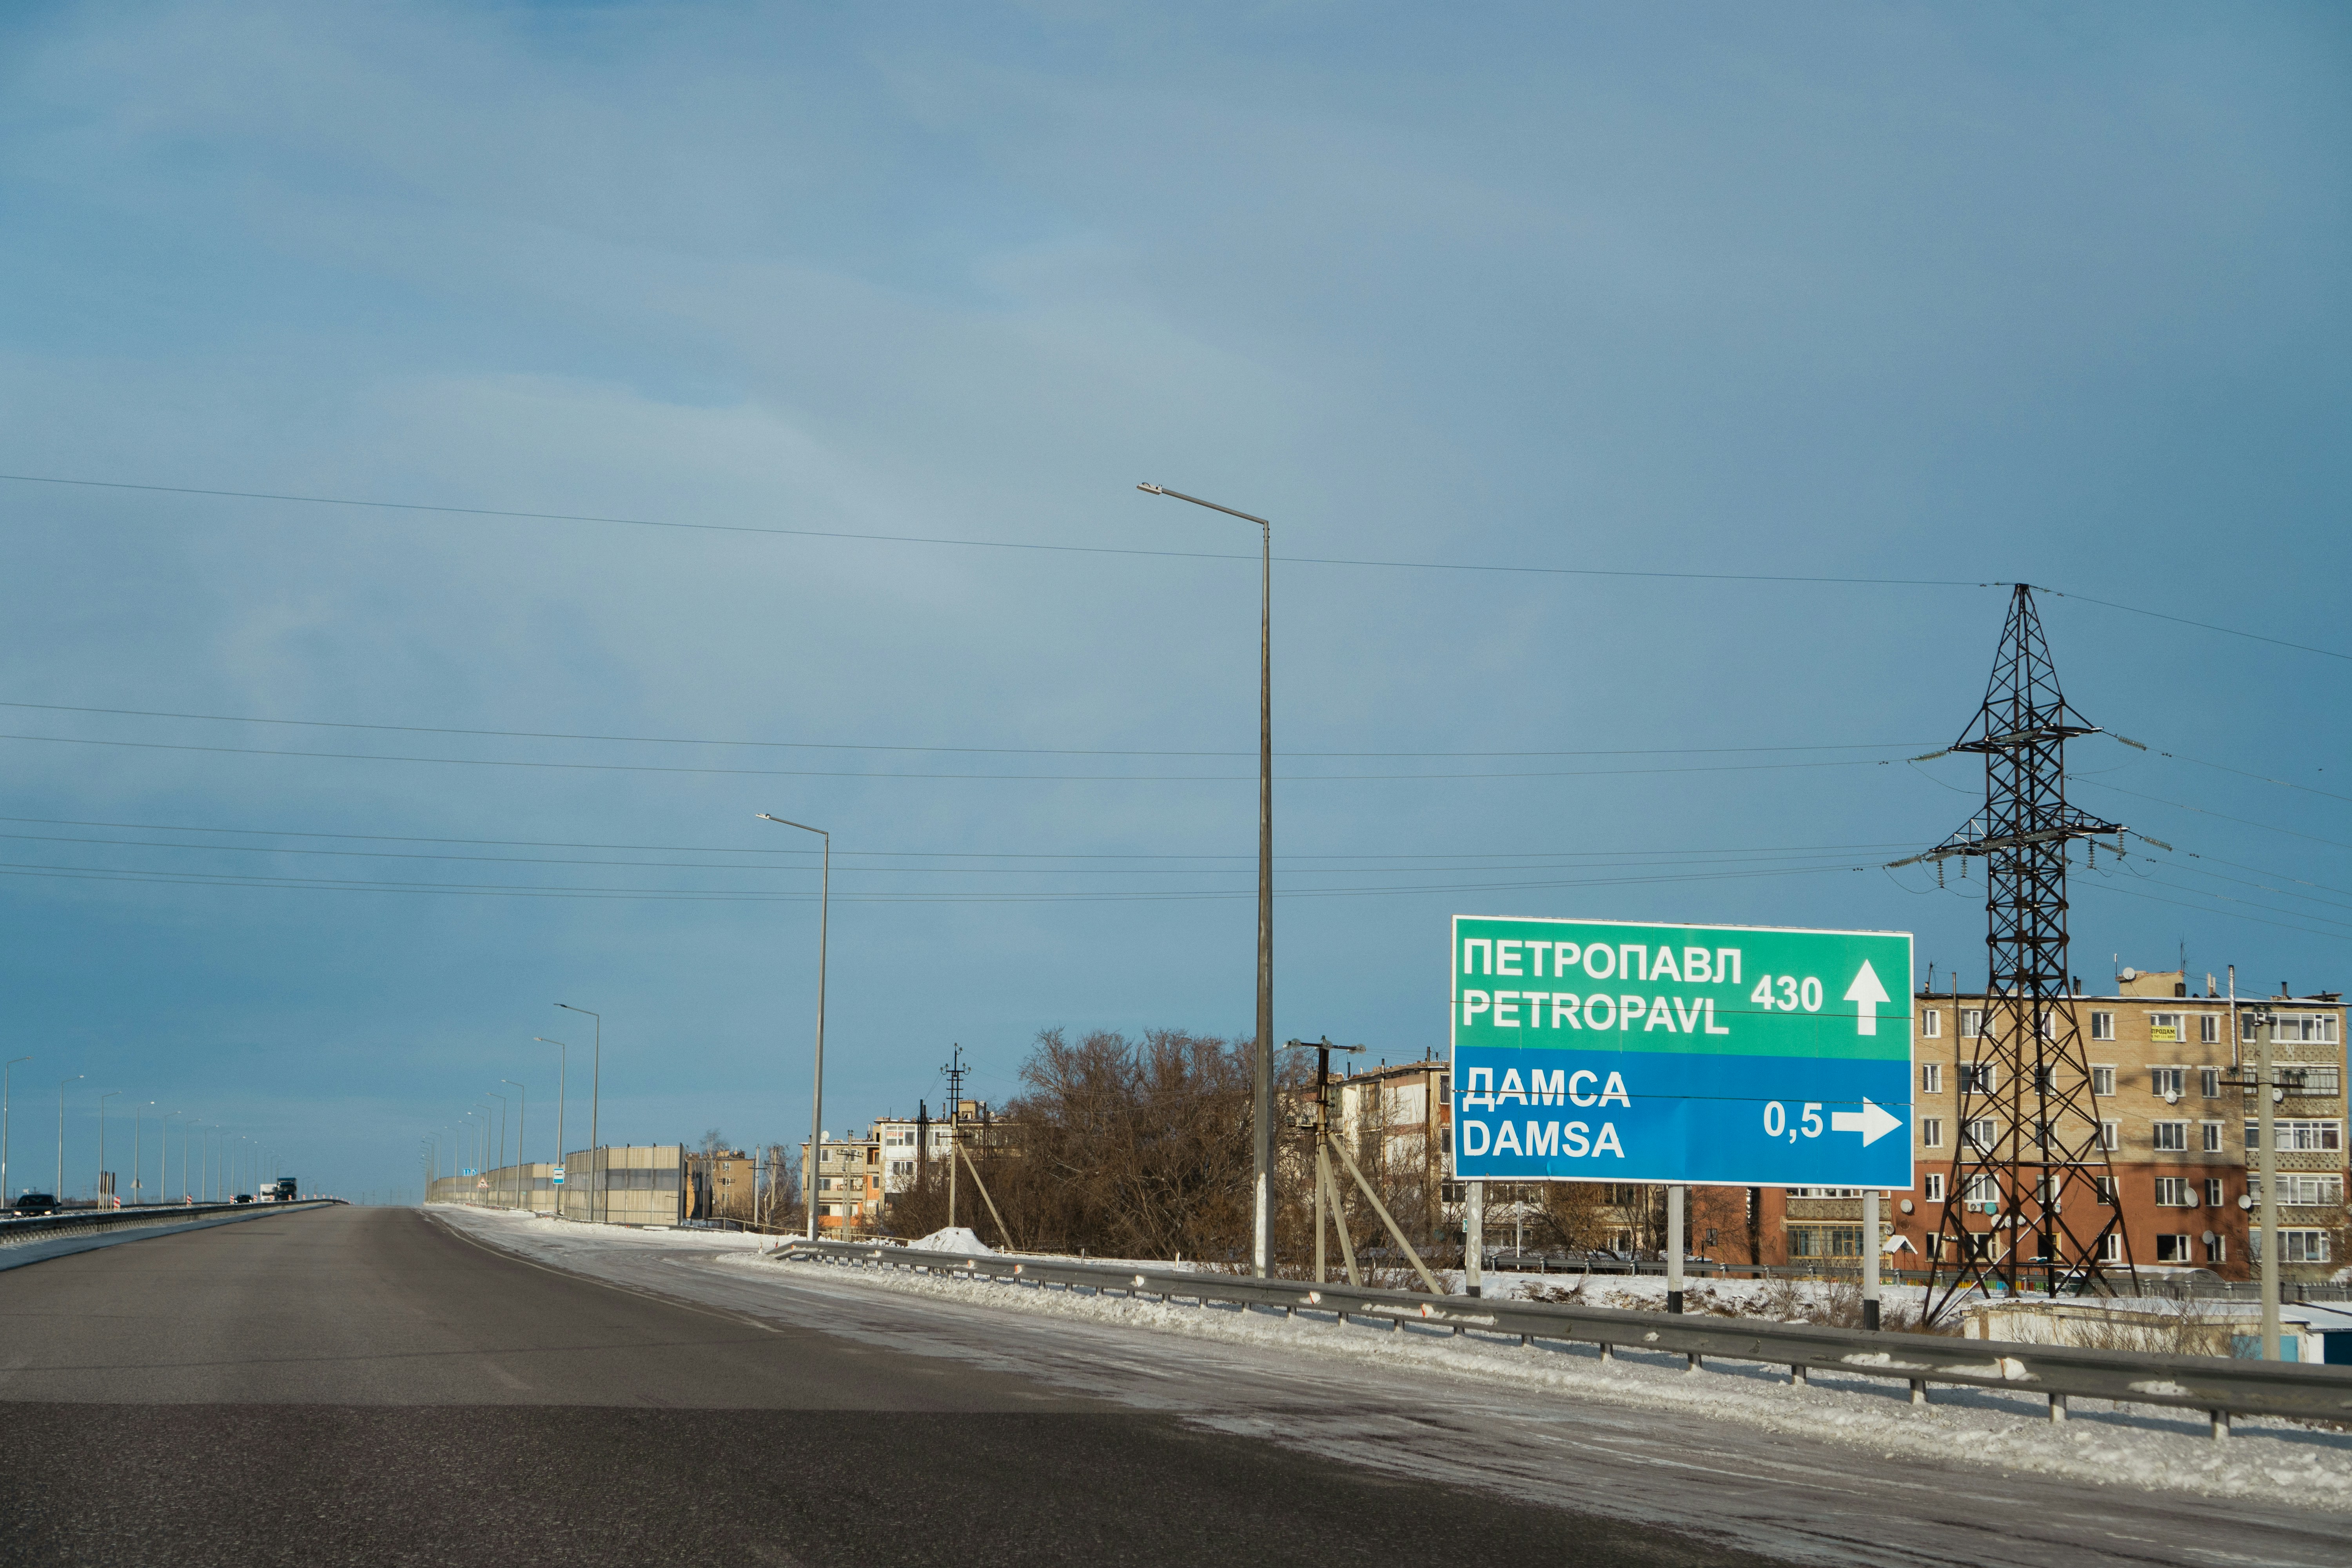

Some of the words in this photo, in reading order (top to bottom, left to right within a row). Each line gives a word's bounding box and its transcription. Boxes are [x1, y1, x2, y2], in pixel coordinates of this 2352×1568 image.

[1464, 938, 1741, 984] ПЕТРОПАВЛ
[1463, 989, 1729, 1034] PETROPAVL
[1751, 975, 1823, 1012] 430
[1463, 1067, 1631, 1112] ДАМСА
[1463, 1120, 1625, 1158] DAMSA
[1764, 1101, 1823, 1144] 0,5
